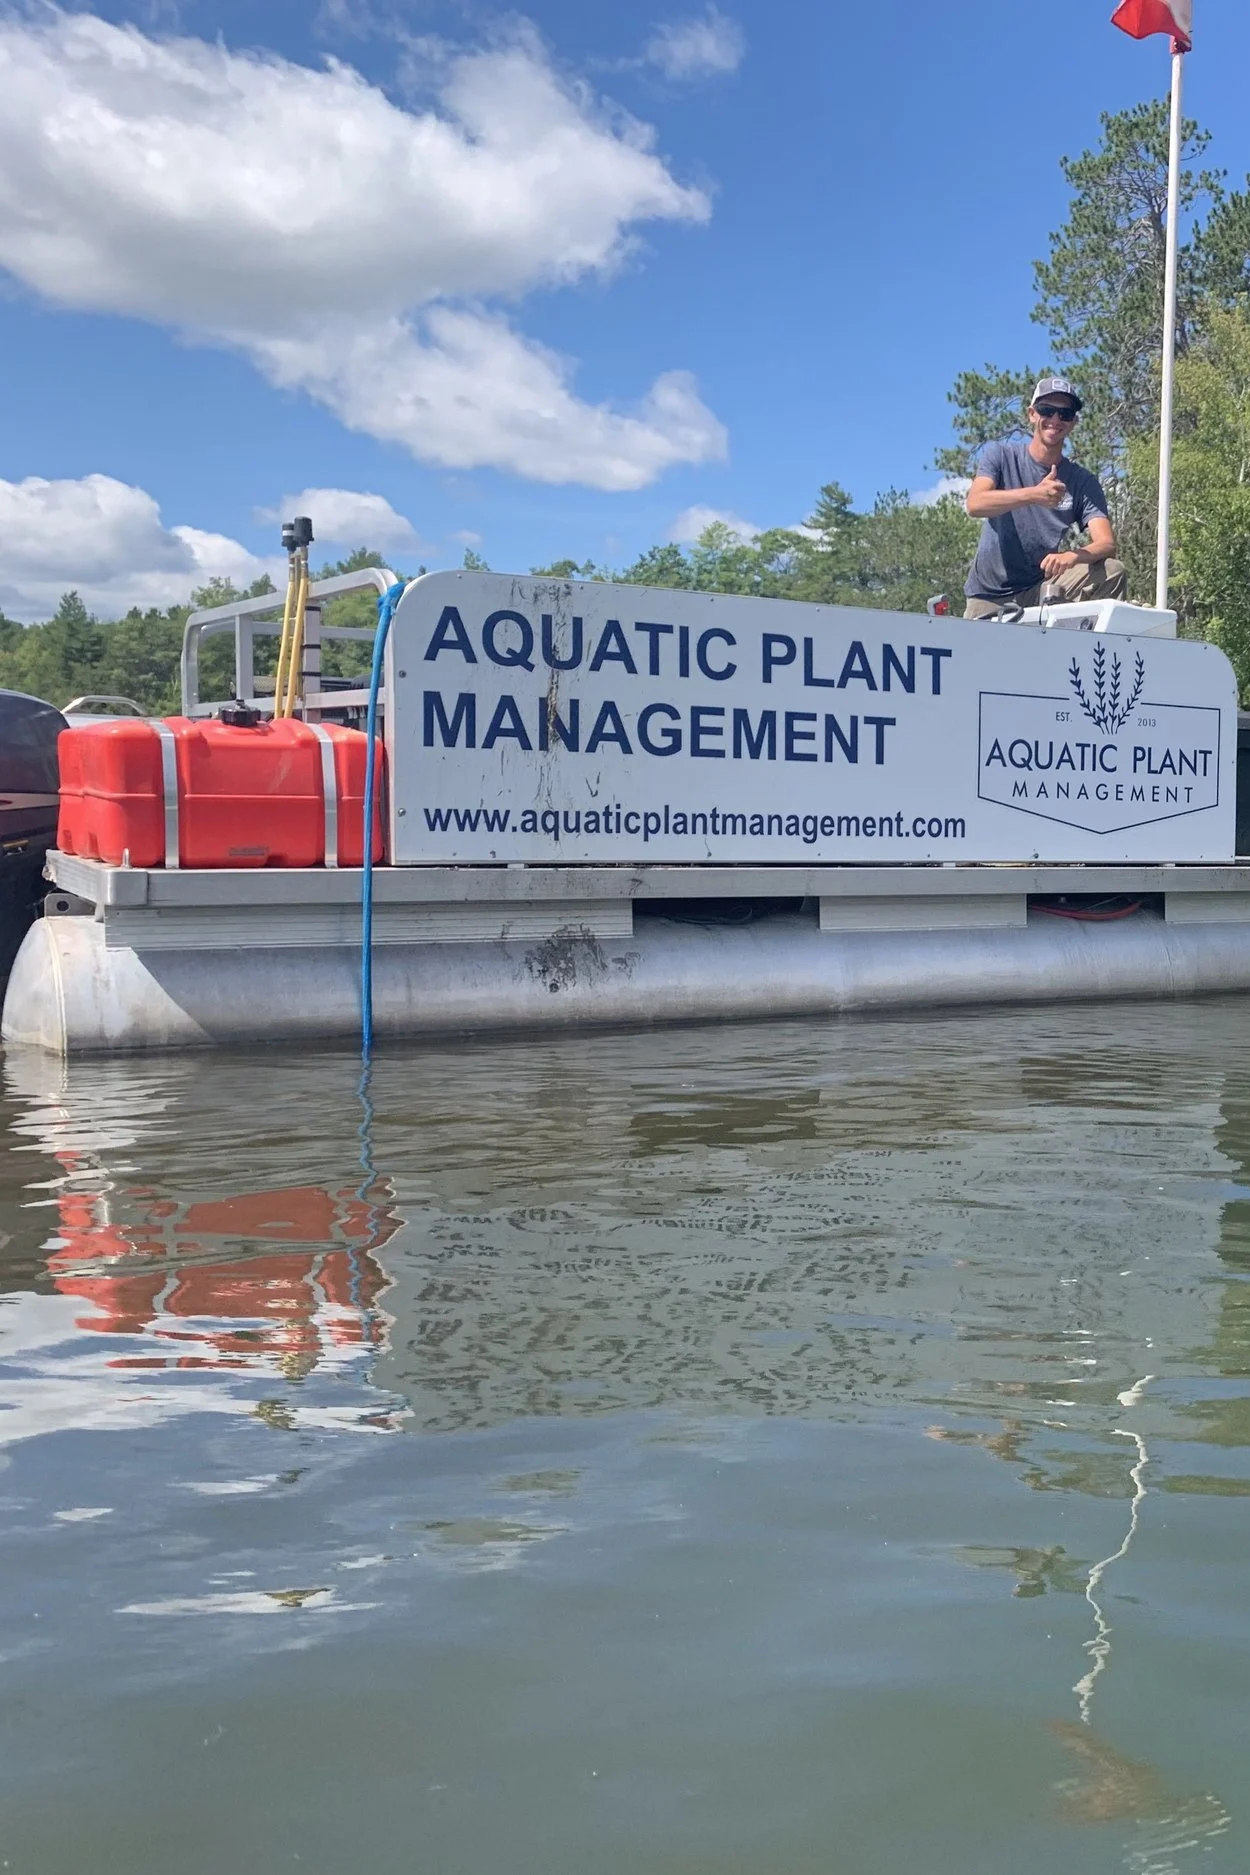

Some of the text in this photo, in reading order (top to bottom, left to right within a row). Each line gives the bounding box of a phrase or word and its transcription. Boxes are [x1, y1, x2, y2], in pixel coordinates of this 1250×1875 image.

[424, 605, 953, 696] AQUATIC PLANT
[423, 690, 897, 766] MANAGEMENT
[1055, 711, 1073, 723] EST.
[1137, 717, 1157, 728] 2013
[985, 737, 1213, 777] AQUATIC PLANT
[1012, 780, 1194, 804] MANAGEMENT
[423, 803, 966, 844] www.aquaticplantmanagement.com
